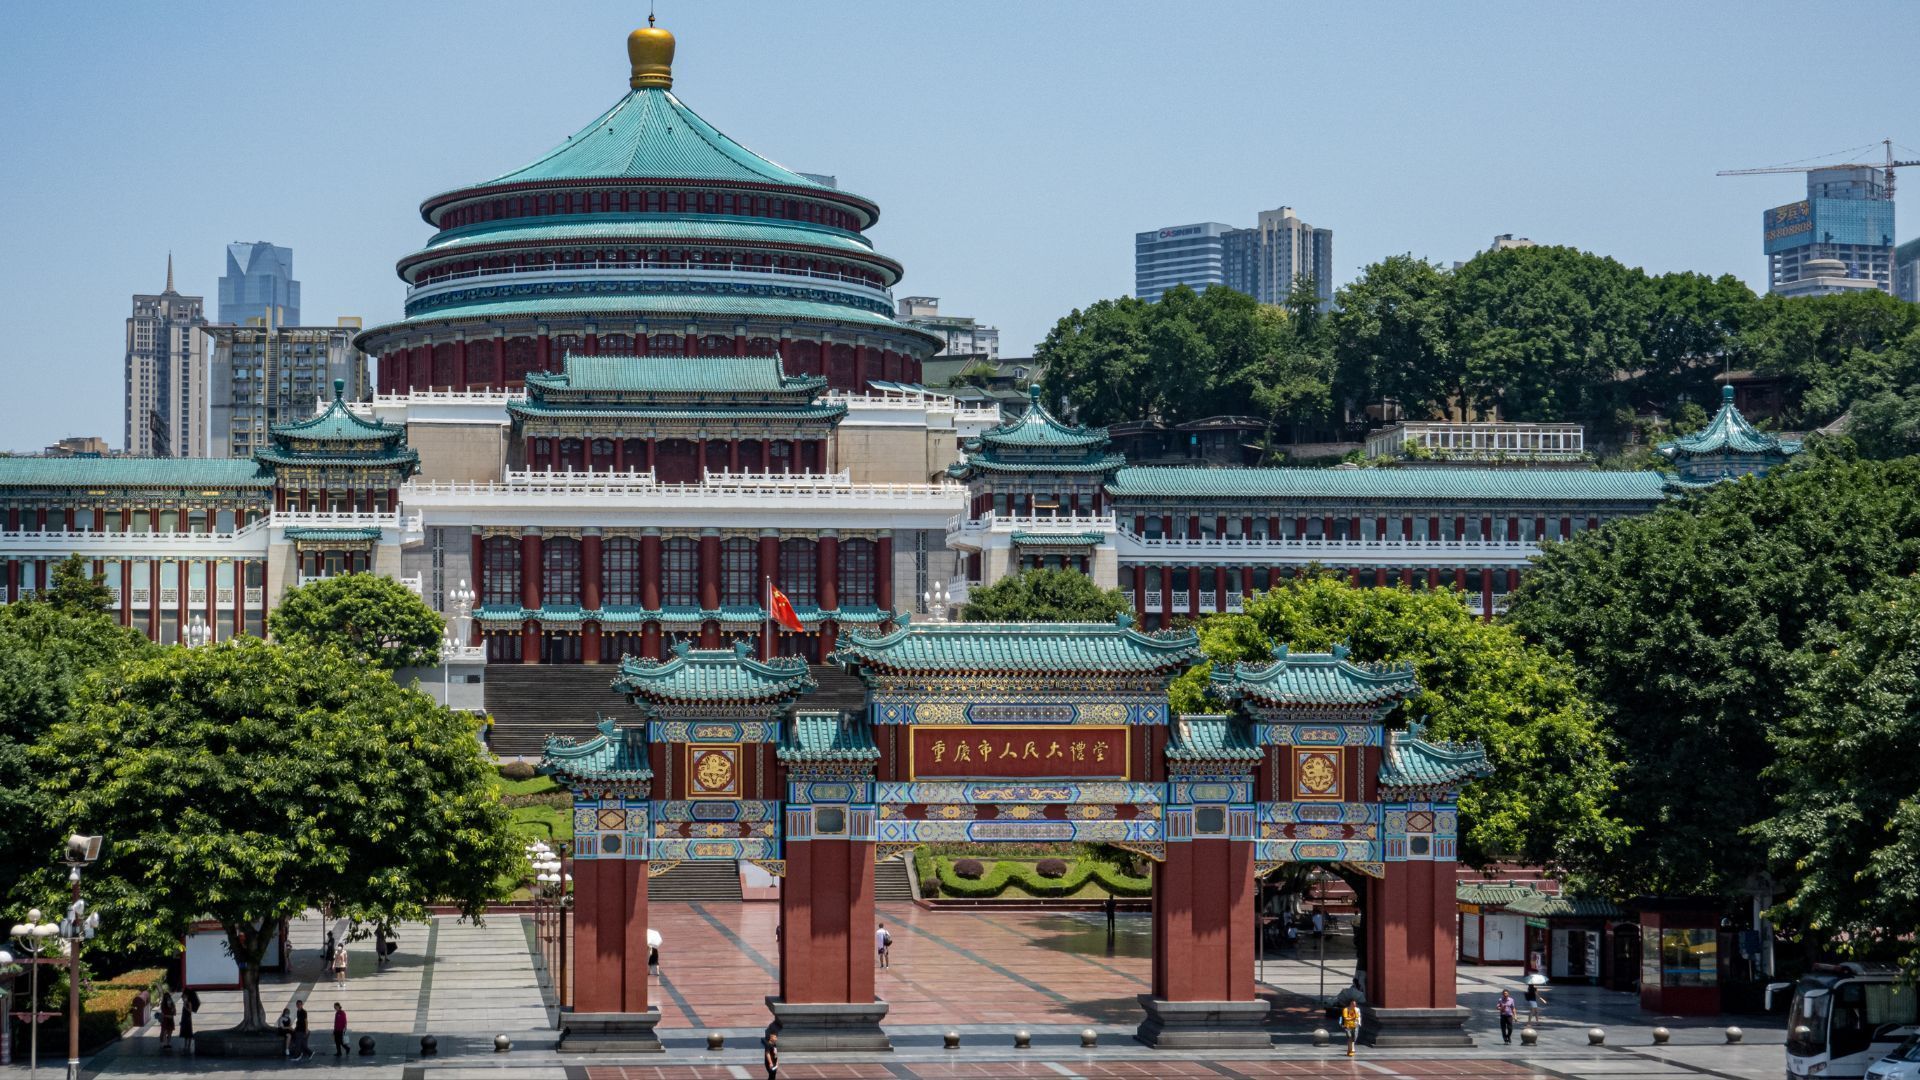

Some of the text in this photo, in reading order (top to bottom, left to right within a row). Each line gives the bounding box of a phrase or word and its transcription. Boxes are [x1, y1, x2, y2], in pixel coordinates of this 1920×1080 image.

[931, 739, 1109, 763] 重慶市人民大禮堂
